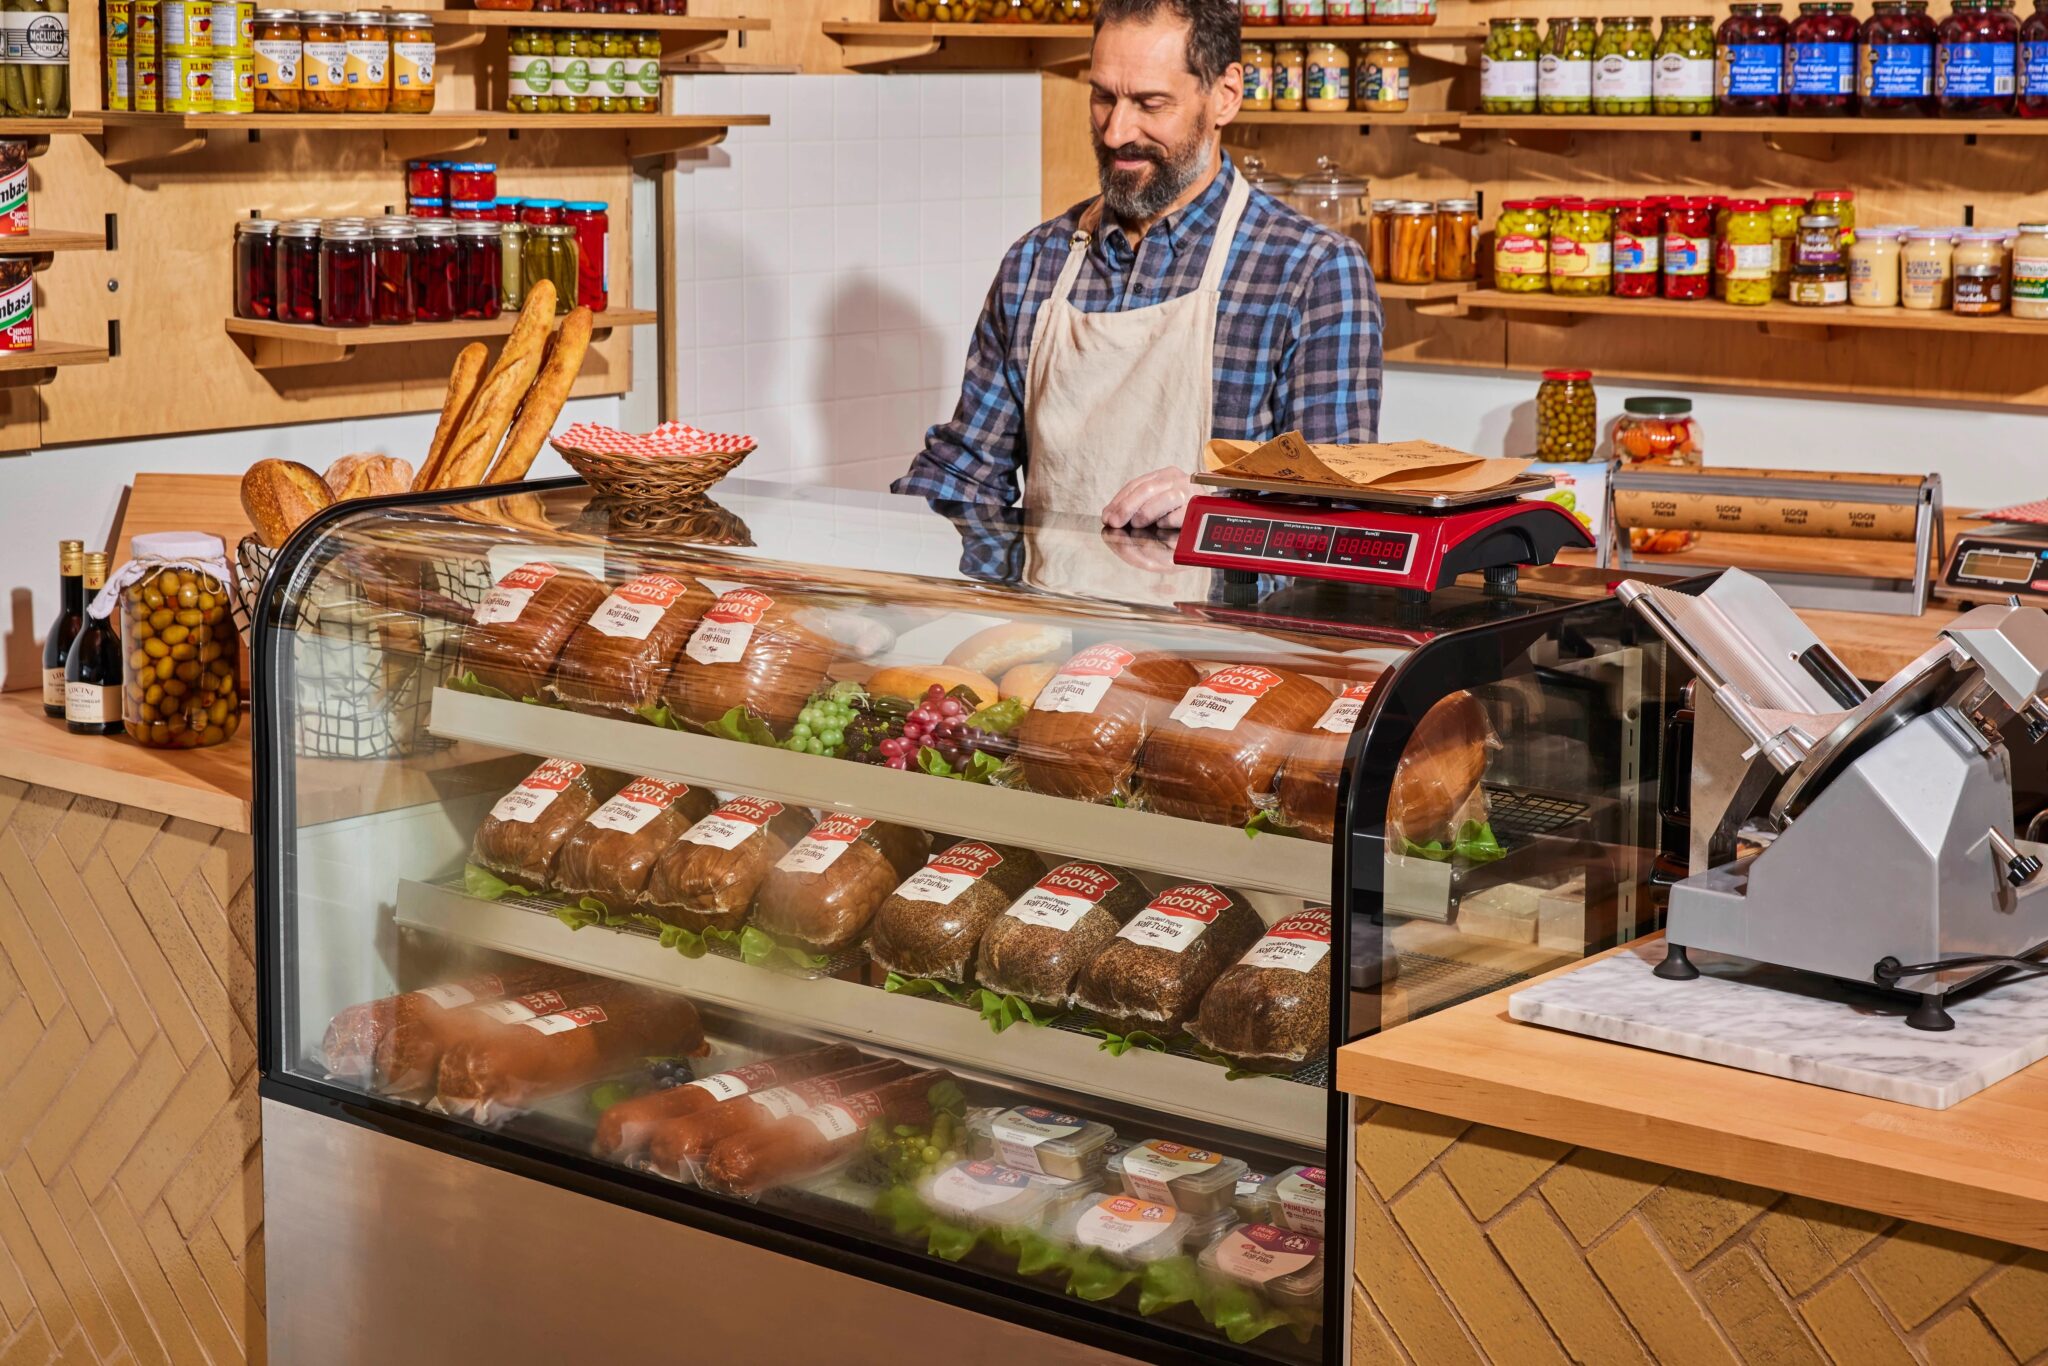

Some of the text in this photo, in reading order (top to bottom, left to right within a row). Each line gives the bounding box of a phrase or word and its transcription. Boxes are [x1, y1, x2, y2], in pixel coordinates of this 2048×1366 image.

[1651, 501, 1677, 510] ROOTS
[1715, 505, 1742, 514] ROOTS
[1781, 508, 1808, 517] ROOTS
[1848, 512, 1876, 521] ROOTS
[506, 571, 540, 584] OOTS
[606, 608, 640, 623] Koji-Ham
[711, 602, 755, 617] ROOTS
[1209, 674, 1261, 690] ROOTS
[1189, 698, 1227, 713] Koji-Ham
[1213, 695, 1235, 705] Smoked
[1333, 708, 1361, 716] Koji-H
[626, 782, 669, 801] ROOTS
[947, 846, 993, 861] PRIME
[935, 855, 982, 871] ROOTS
[1060, 866, 1110, 885] PRIME
[908, 877, 951, 892] Koji-Turkey
[1047, 874, 1099, 895] ROOTS
[1034, 894, 1071, 907] Cracked Pepper
[1173, 886, 1222, 904] PRIME
[1023, 899, 1070, 916] Koji-Turkey
[1158, 895, 1211, 915] ROOTS
[1144, 915, 1165, 923] Cracked
[1134, 920, 1182, 937] Koji-Turkey
[1276, 921, 1331, 936] ROOTS
[1284, 1202, 1322, 1217] PRIME ROOTS
